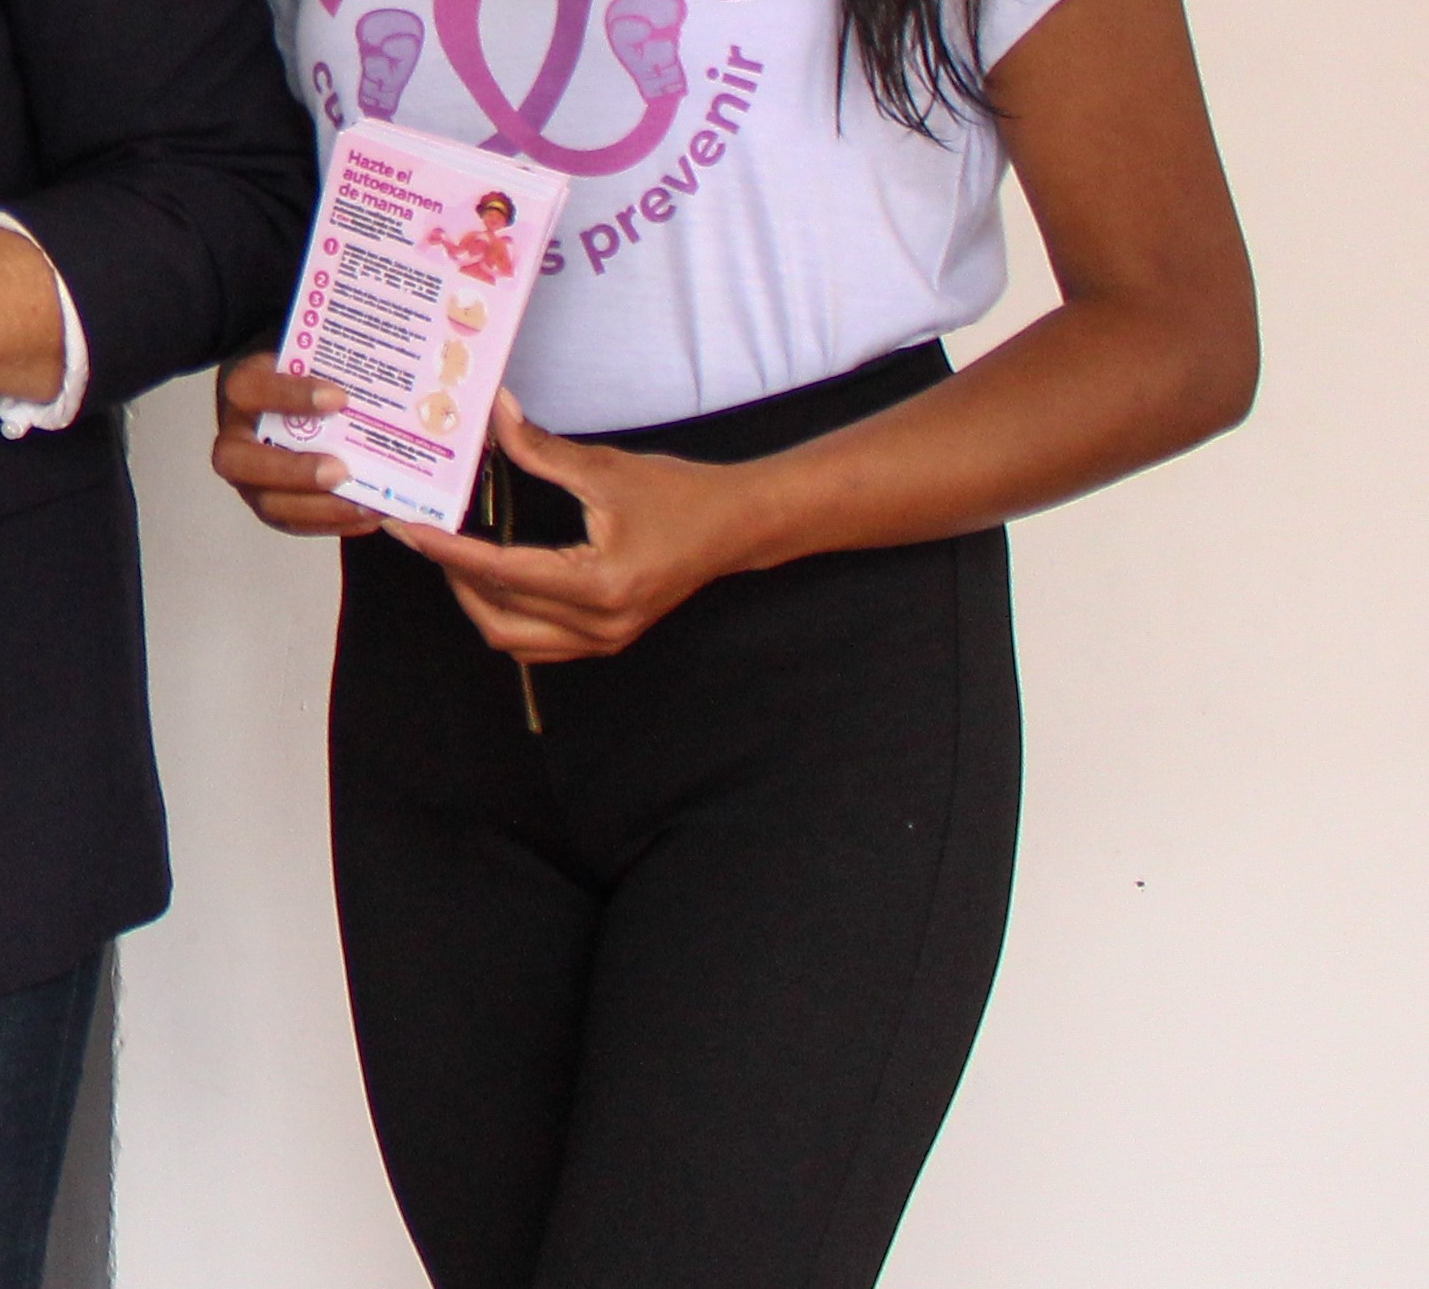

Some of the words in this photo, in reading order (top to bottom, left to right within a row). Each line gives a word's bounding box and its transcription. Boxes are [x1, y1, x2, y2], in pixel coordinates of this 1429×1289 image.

[348, 150, 394, 178] Hazte
[396, 170, 413, 185] el
[579, 45, 764, 276] prevenir
[339, 183, 359, 200] de
[362, 193, 414, 221] mama
[343, 169, 443, 214] autoexamen
